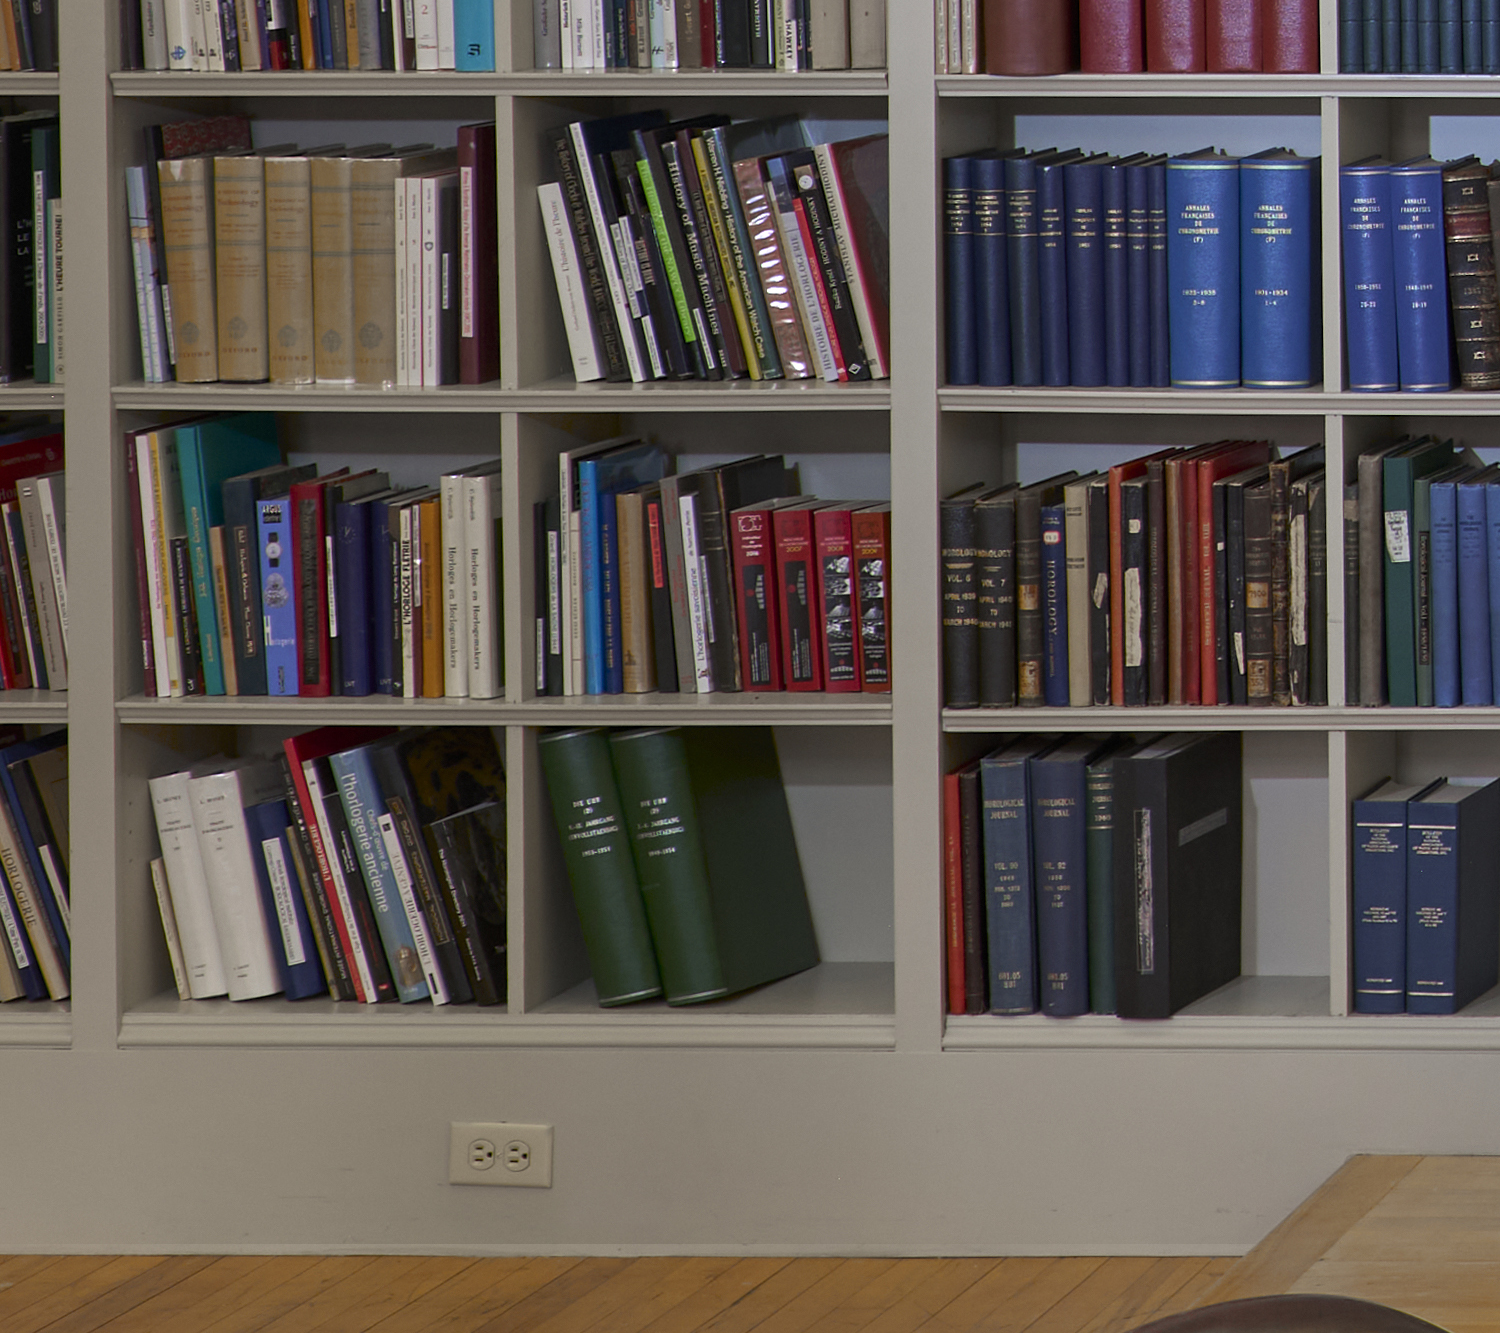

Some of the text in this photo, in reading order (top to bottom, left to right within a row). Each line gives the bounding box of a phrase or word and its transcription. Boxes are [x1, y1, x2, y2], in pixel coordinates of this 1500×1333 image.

[783, 18, 793, 60] SHAWKEY
[705, 136, 720, 168] Warren
[666, 159, 689, 211] History
[714, 175, 730, 210] Niebling
[548, 199, 570, 272] L'histoire de l'heure
[680, 212, 693, 227] of
[723, 213, 739, 245] History
[685, 231, 704, 270] Music
[733, 253, 745, 270] the
[835, 232, 855, 284] STANISLAV
[696, 272, 721, 335] Machines
[737, 268, 754, 309] American
[789, 233, 832, 370] HISTOIRE DE L'HORLOGERIE
[747, 309, 761, 336] Watch
[753, 335, 766, 359] Case
[262, 505, 282, 514] ARGUS
[401, 574, 413, 625] L'HORLOGE
[447, 546, 457, 669] Horloges en Horlogemakers
[470, 547, 481, 670] Horloges en Horlogemakers
[688, 567, 707, 661] L'horlogerie savoisienne
[1046, 560, 1058, 636] HOROLOGY
[308, 822, 331, 882] L'HORLOGERIE
[340, 771, 389, 914] l'horlogerie ancienne
